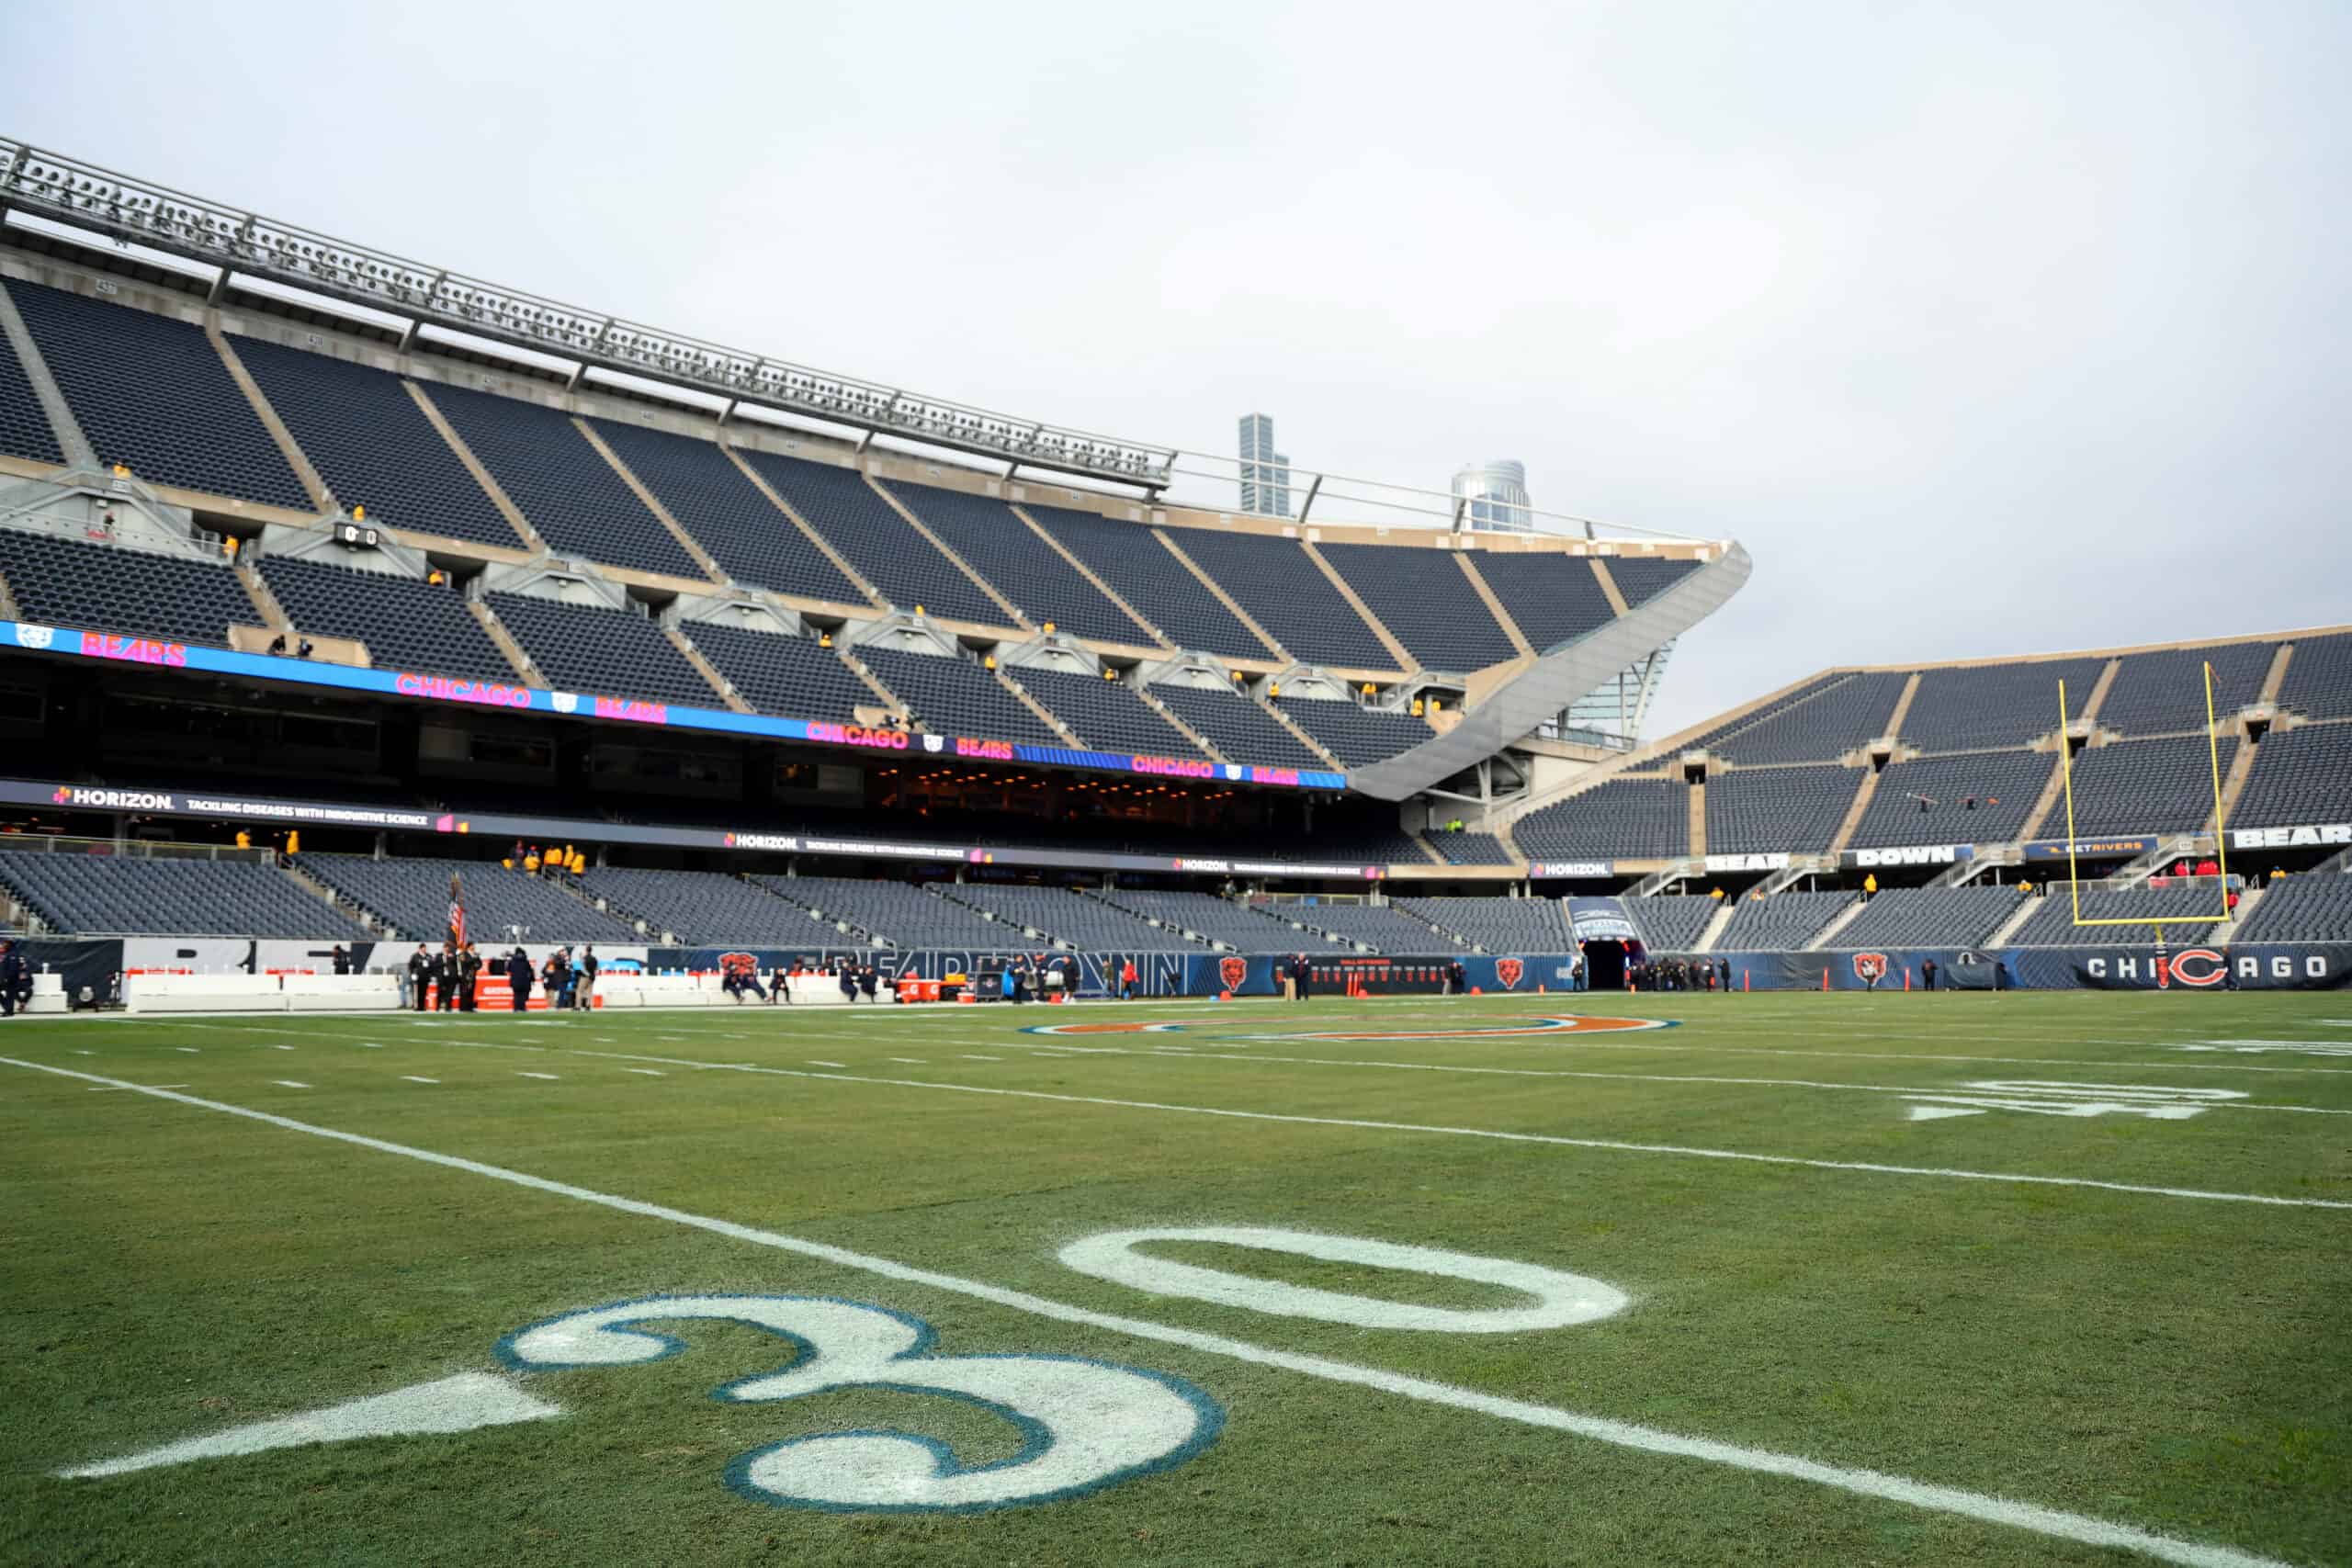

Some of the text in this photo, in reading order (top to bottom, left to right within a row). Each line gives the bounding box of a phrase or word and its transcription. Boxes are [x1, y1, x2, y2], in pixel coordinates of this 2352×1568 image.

[81, 631, 187, 668] BEARS
[396, 672, 667, 724] CHICAGO BEARS
[806, 720, 1013, 760] CHICAGO BEARS
[1131, 755, 1214, 778] CHICAGO
[187, 799, 241, 813] TACKLING
[242, 803, 294, 817] DISEASES
[295, 807, 323, 818] WITH
[387, 813, 428, 825] SCIENCE
[2234, 825, 2351, 848] BEAR
[1705, 852, 1789, 871] BEAR
[1857, 845, 1955, 866] DOWN
